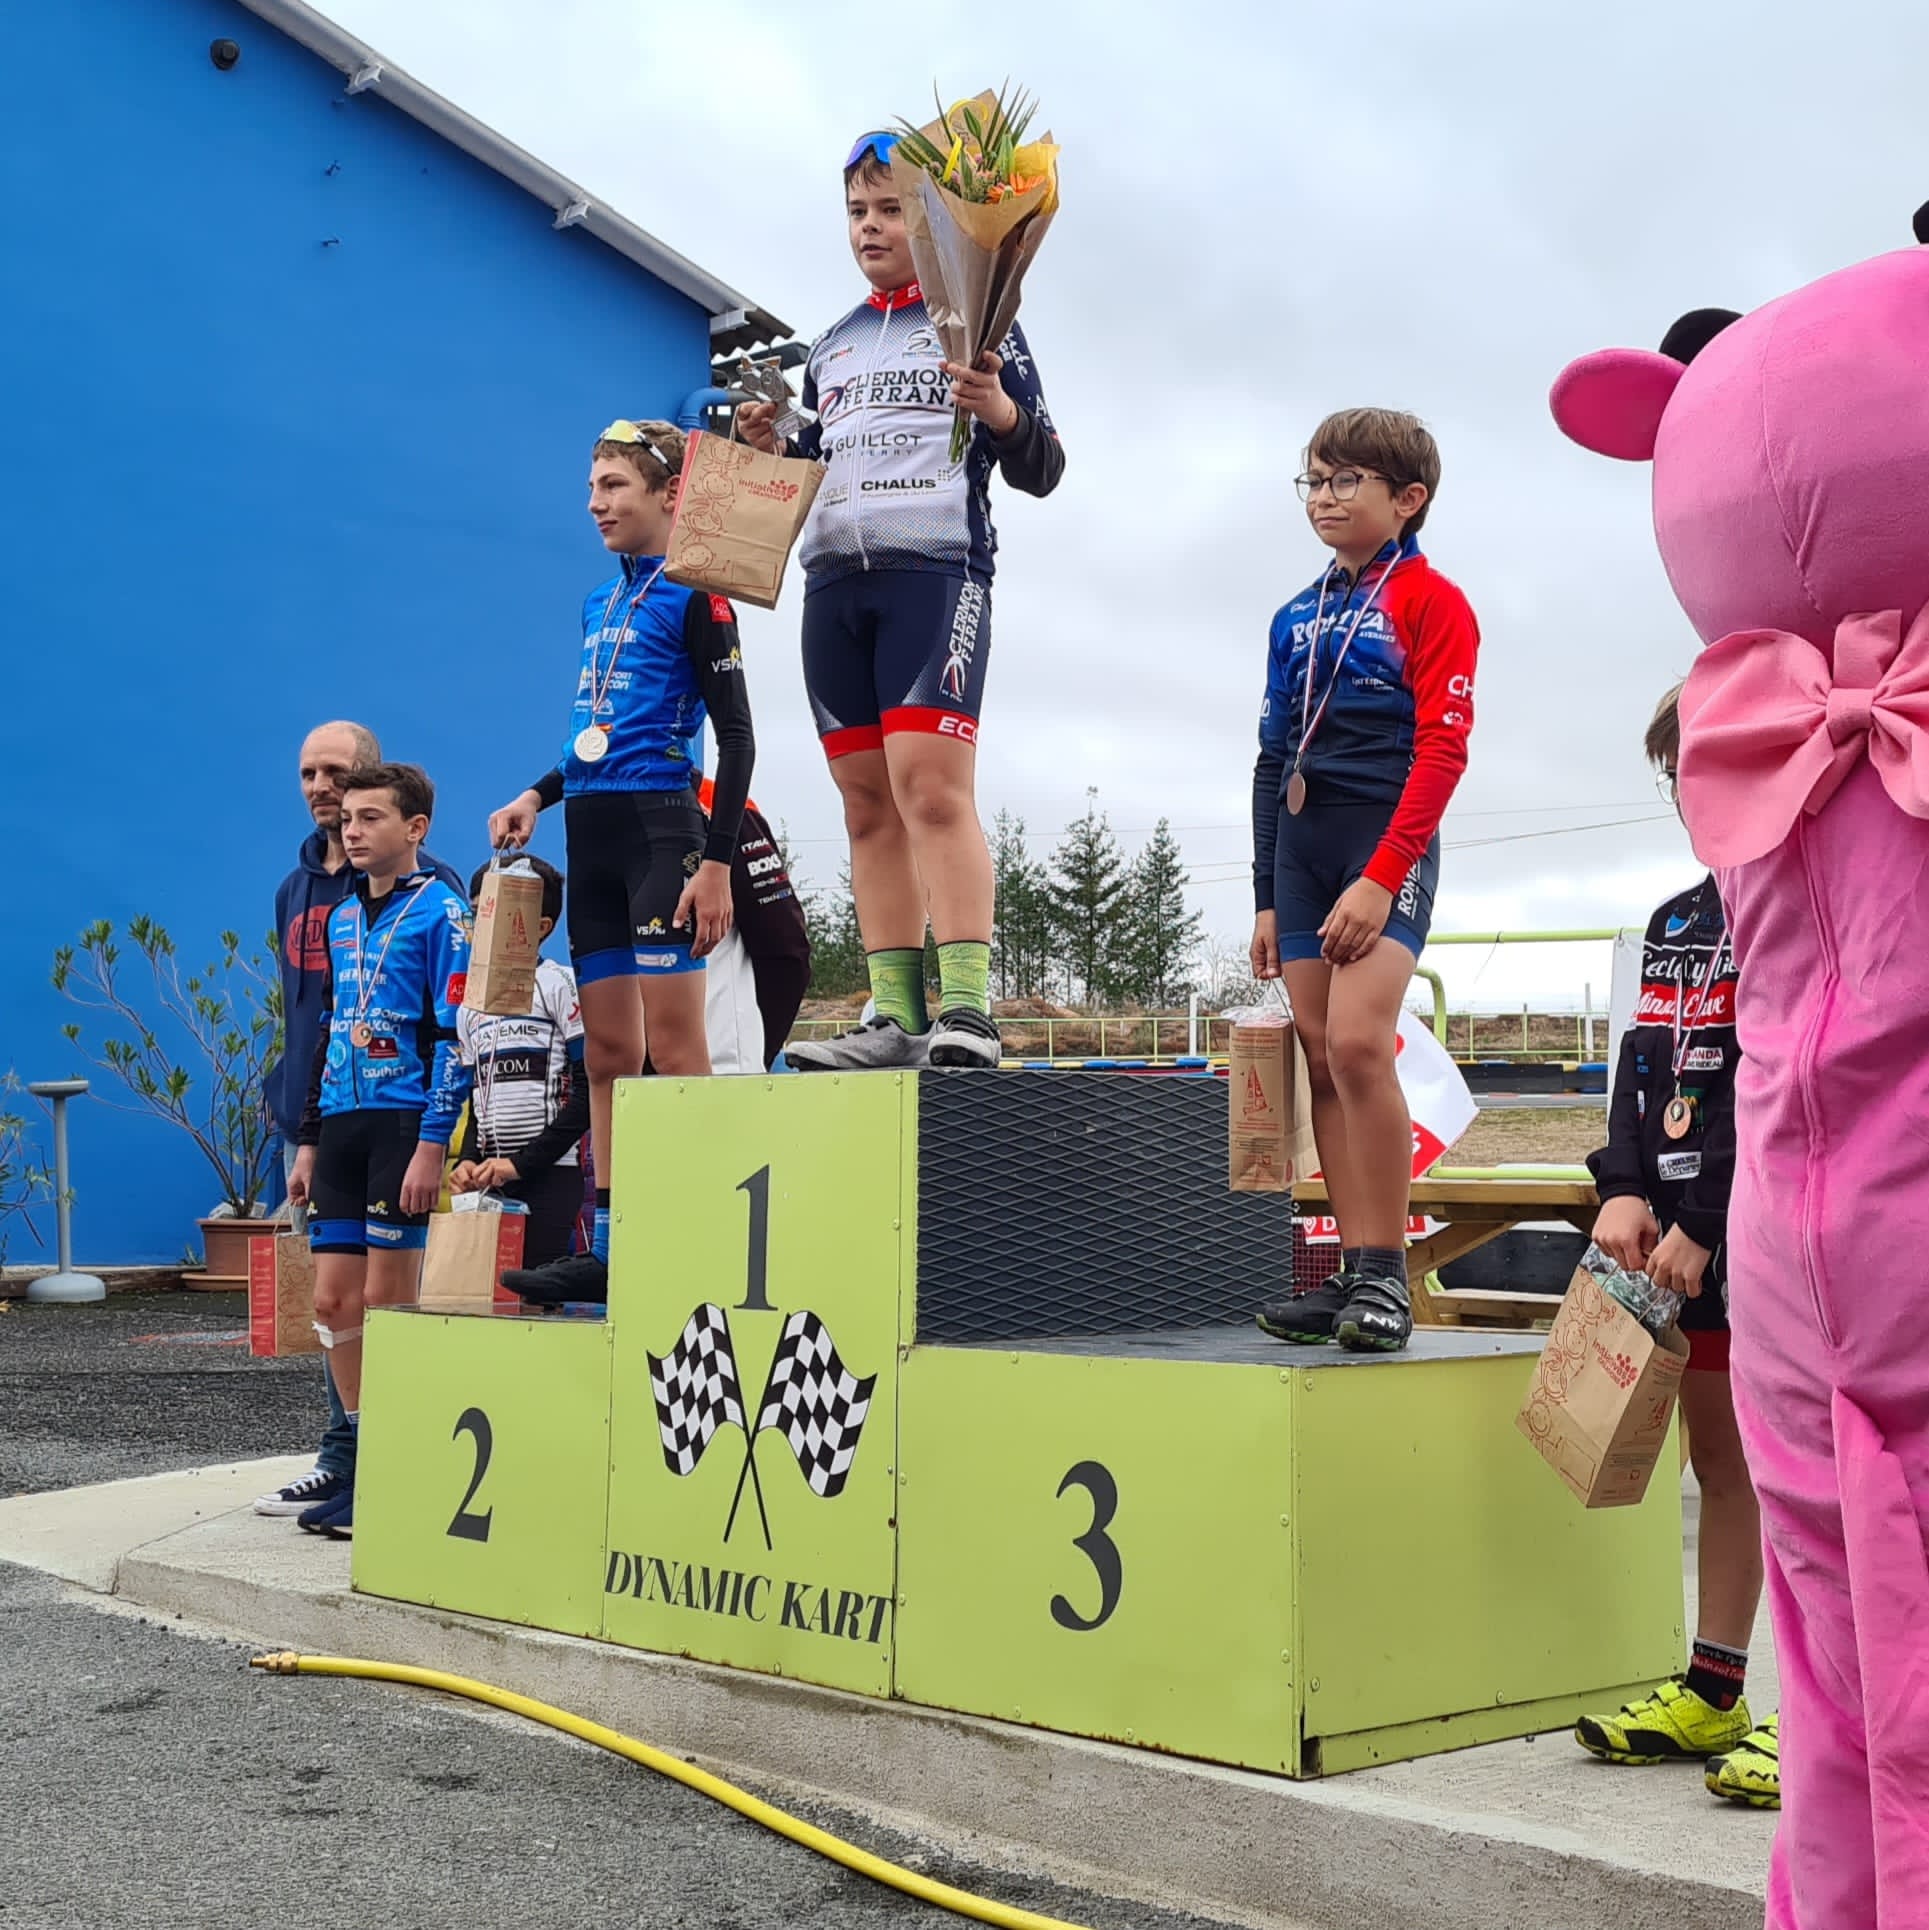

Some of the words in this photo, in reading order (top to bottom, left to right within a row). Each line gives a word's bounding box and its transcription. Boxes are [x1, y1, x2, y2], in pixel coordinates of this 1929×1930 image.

[835, 433, 922, 452] GUILLOT
[861, 478, 937, 492] CHALUS
[735, 1163, 780, 1313] 1
[447, 1408, 492, 1542] 2
[604, 1550, 772, 1623] DYNAMIC
[779, 1580, 896, 1644] KART
[1051, 1461, 1122, 1631] 3
